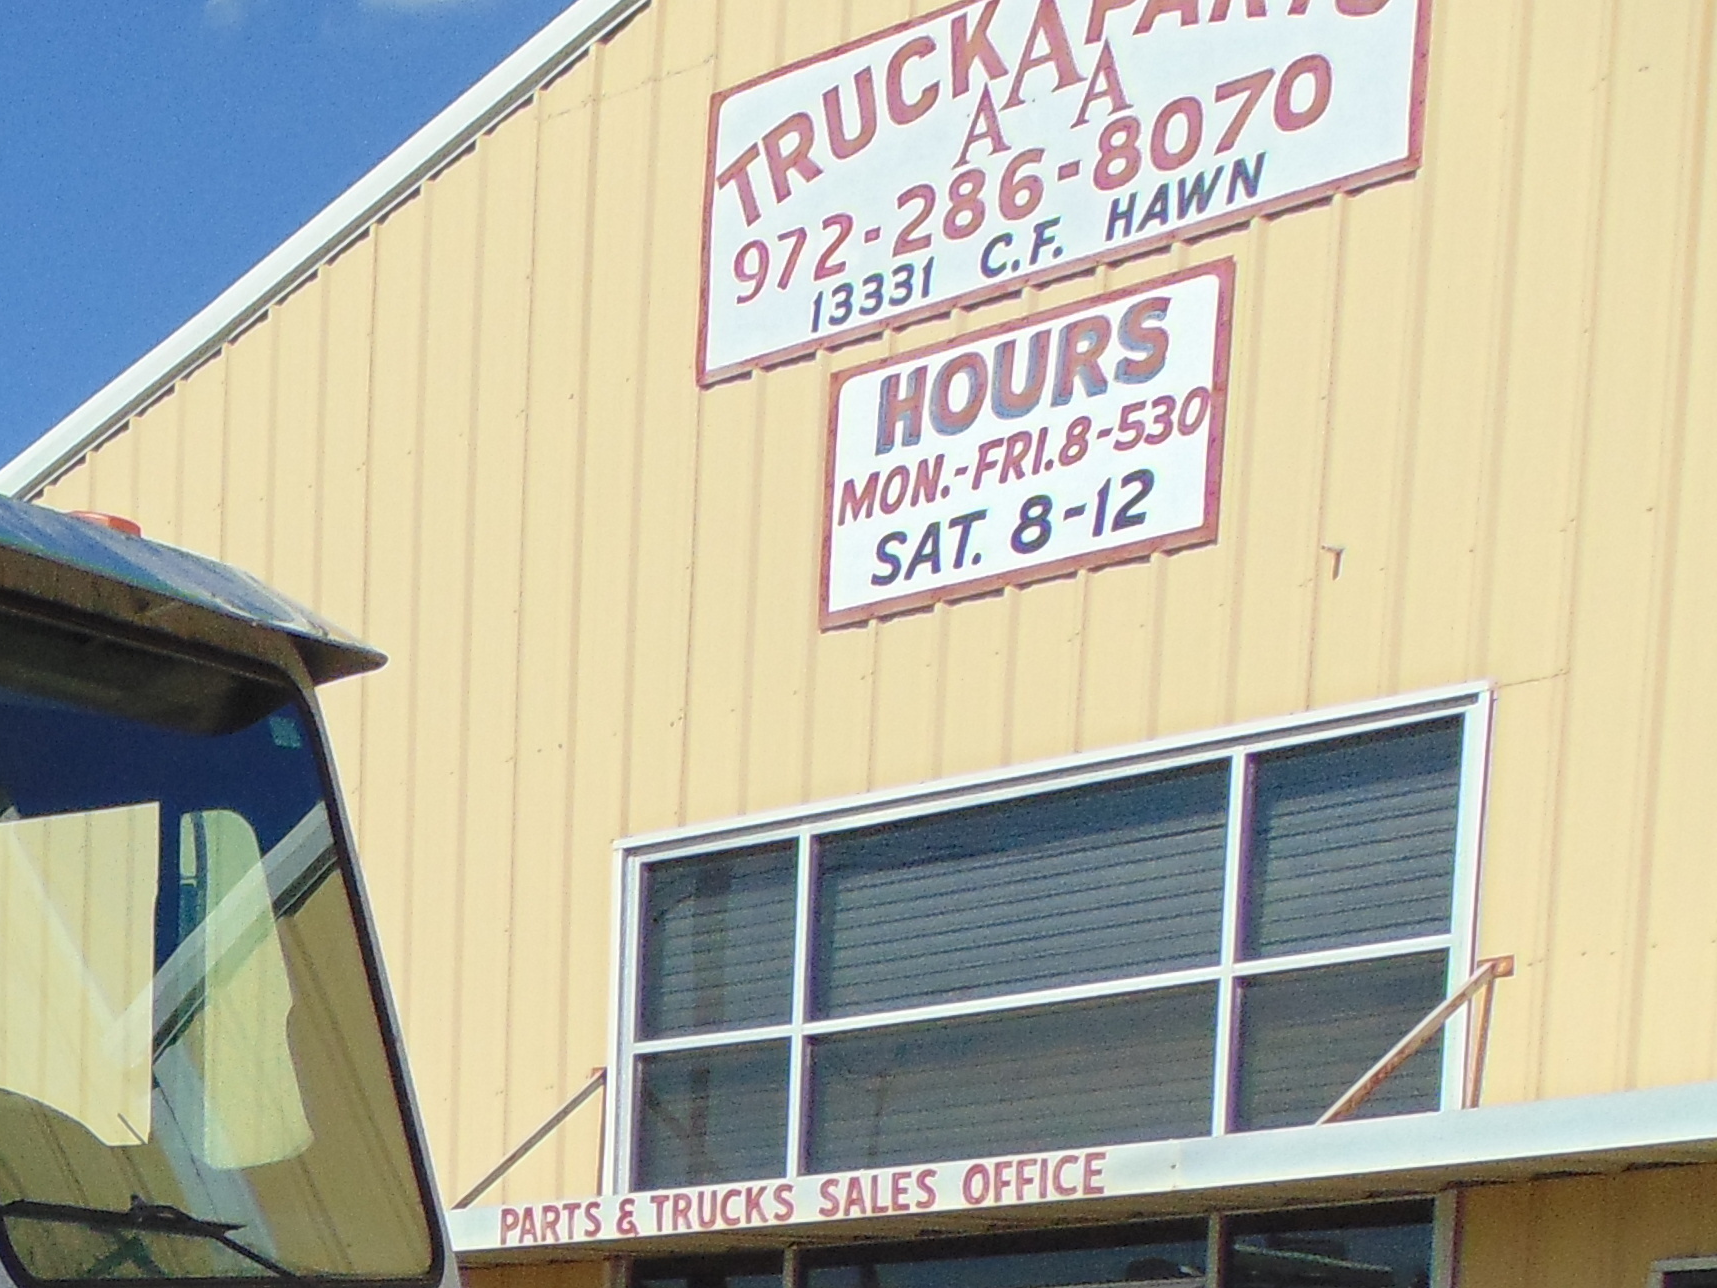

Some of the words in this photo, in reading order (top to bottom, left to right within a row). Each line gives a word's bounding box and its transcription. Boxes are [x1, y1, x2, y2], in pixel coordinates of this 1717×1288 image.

[717, 0, 1009, 227] TRUCK
[734, 53, 1333, 305] 972-286-8070
[811, 256, 934, 333] 13331
[981, 217, 1064, 278] C.F.
[1105, 151, 1266, 243] HAWN
[875, 297, 1172, 456] HOURS
[871, 509, 988, 586] SAT.
[1011, 469, 1155, 554] 8-12
[500, 1201, 602, 1245] PARTS
[616, 1197, 640, 1237] &
[650, 1184, 794, 1232] TRUCKS
[819, 1168, 939, 1217] SALES
[964, 1152, 1107, 1205] OFFICE
